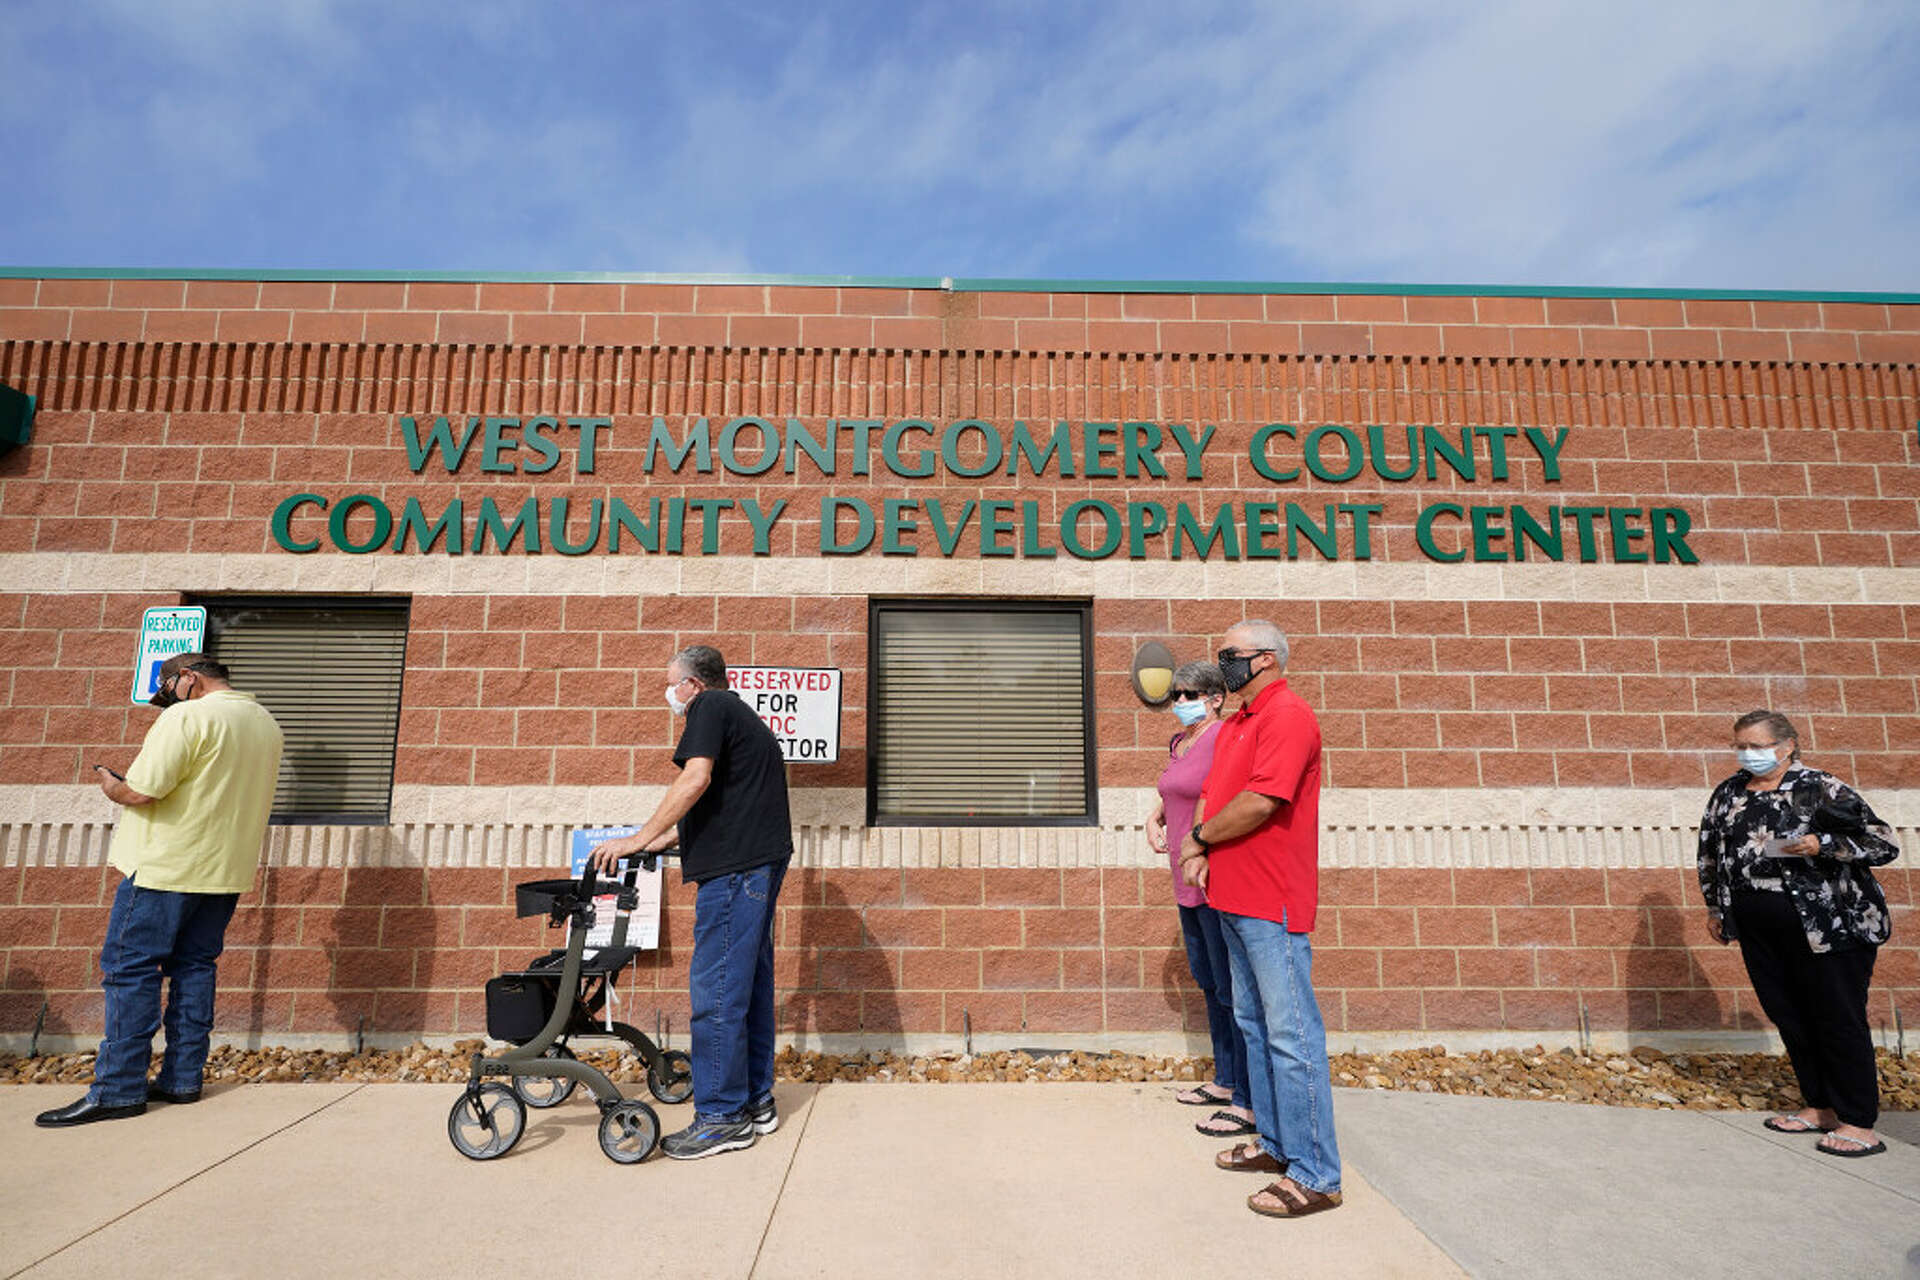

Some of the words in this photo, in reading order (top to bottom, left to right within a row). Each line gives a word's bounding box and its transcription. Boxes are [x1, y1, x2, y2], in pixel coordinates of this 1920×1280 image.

[400, 416, 612, 474] WEST
[642, 416, 1216, 482] MONTGOMERY
[1249, 424, 1569, 483] COUNTY
[271, 493, 787, 555] COMMUNITY
[820, 496, 1382, 561] DEVELOPMENT
[1416, 502, 1700, 565] CENTER
[147, 617, 199, 631] RESERVED
[147, 638, 193, 653] PARKING
[727, 671, 831, 691] RESERVED
[756, 693, 798, 713] FOR
